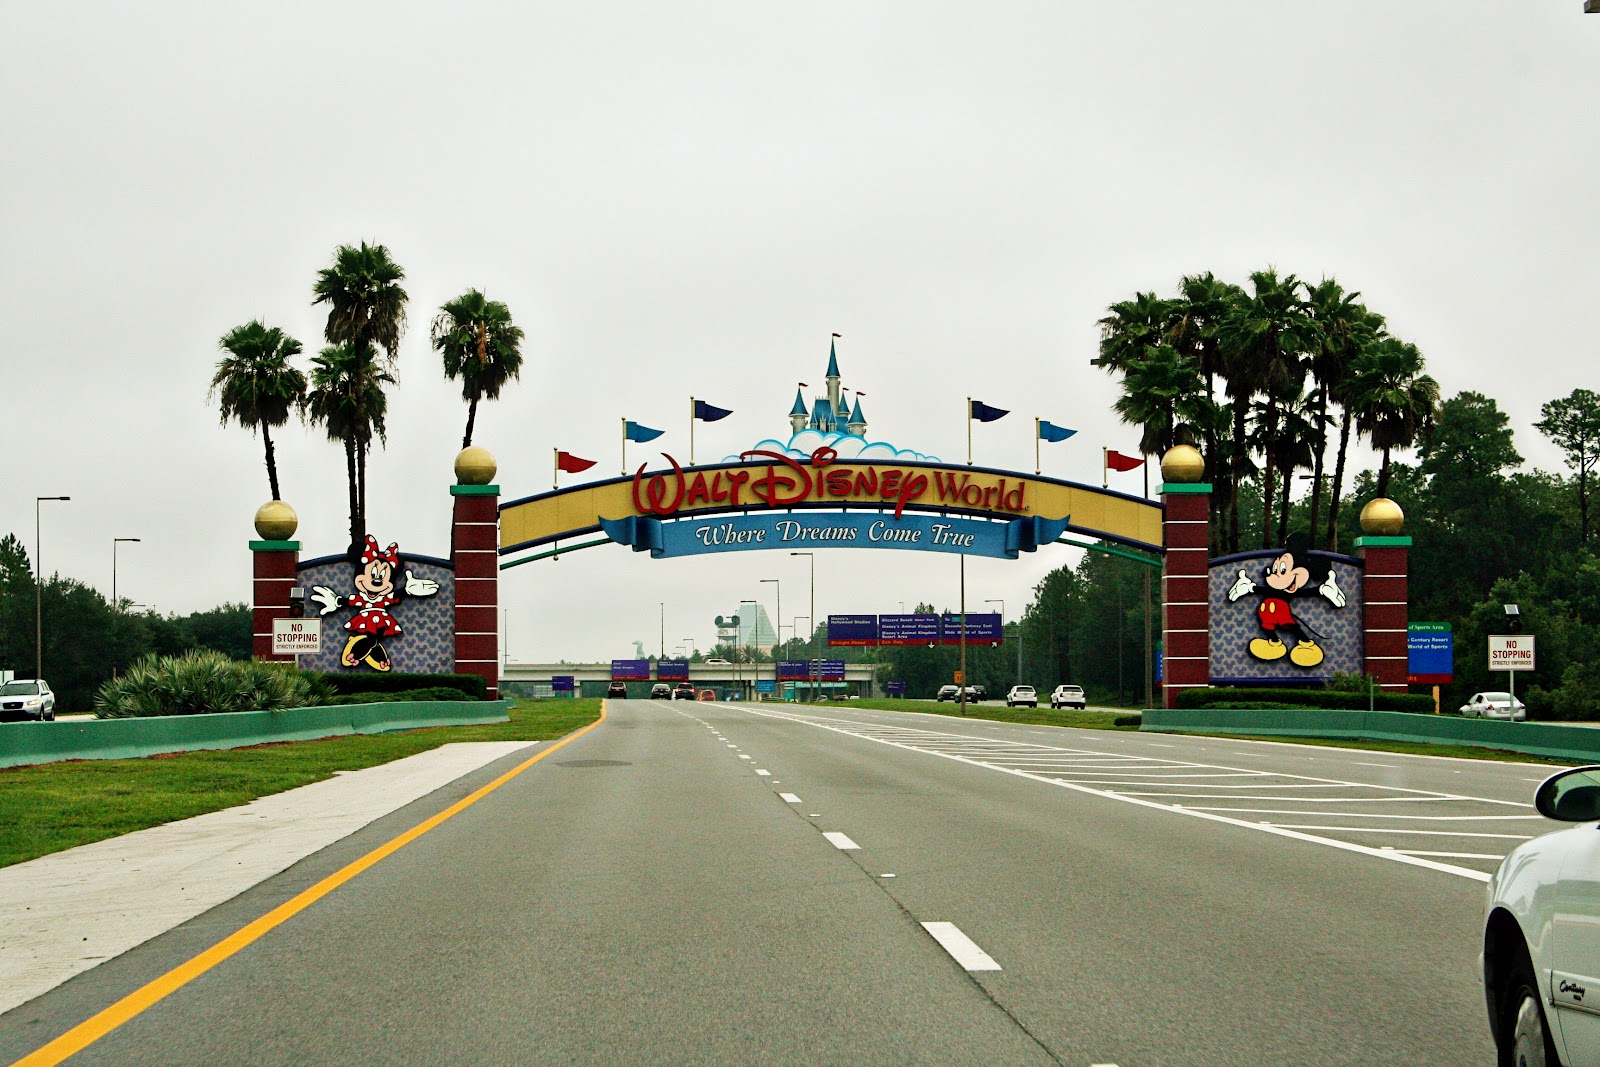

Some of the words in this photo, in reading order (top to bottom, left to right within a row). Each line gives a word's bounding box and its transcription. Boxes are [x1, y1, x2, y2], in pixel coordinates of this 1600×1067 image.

[934, 471, 1025, 511] World
[695, 521, 766, 547] Where
[775, 519, 857, 542] Dreams
[867, 520, 921, 543] Come
[931, 523, 975, 547] True
[291, 623, 303, 632] NO
[276, 633, 318, 643] STOPPING
[1506, 640, 1518, 649] NO
[1492, 650, 1532, 659] STOPPING
